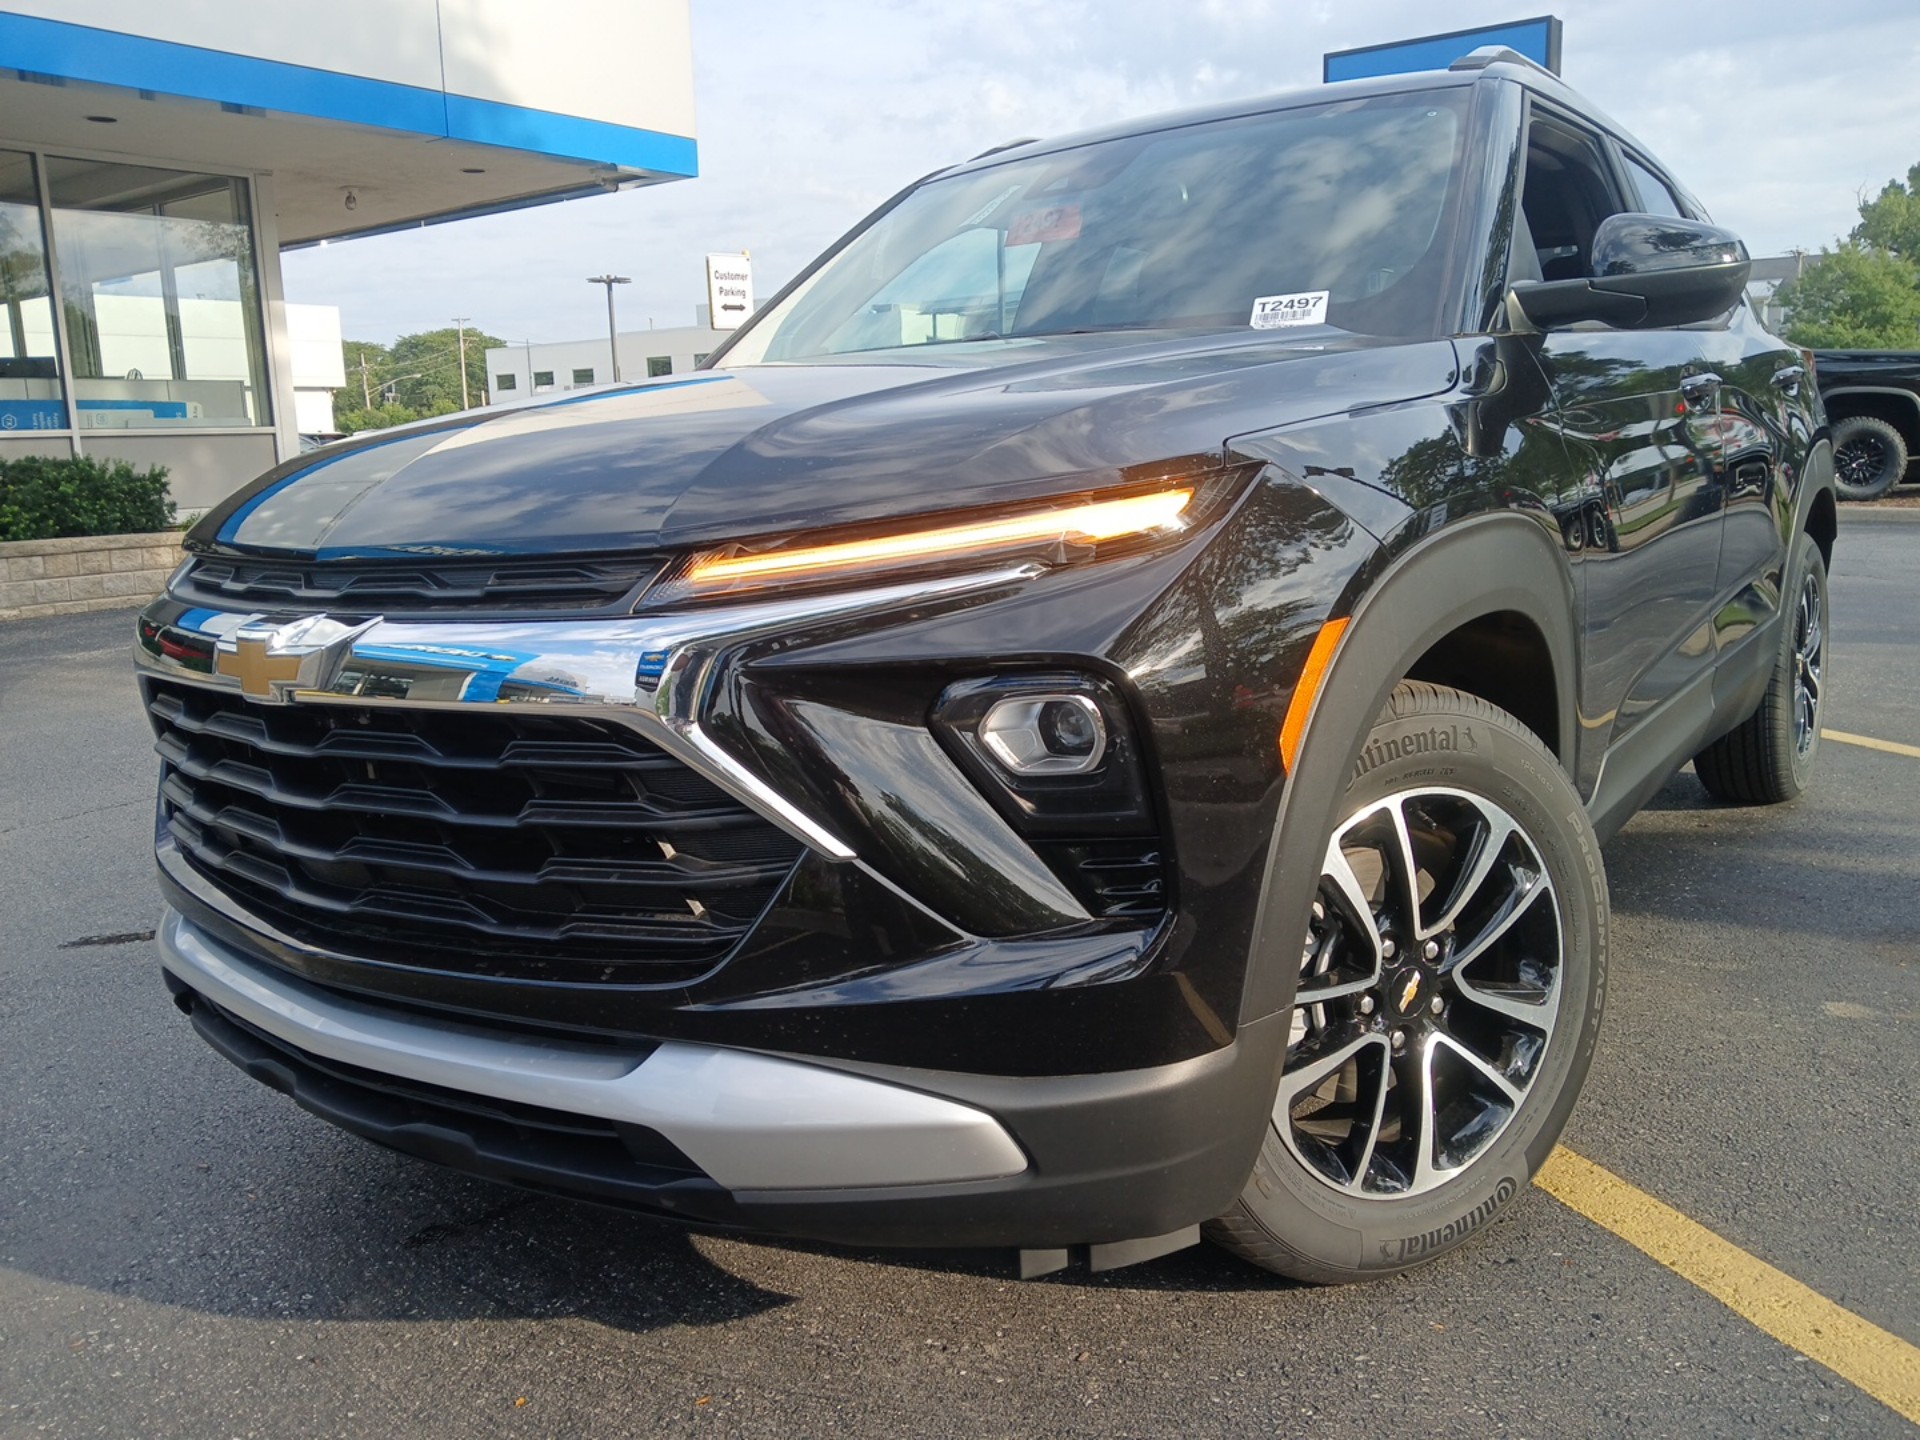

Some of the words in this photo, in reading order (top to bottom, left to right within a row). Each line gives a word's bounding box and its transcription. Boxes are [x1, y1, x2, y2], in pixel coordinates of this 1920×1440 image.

[714, 270, 748, 281] Customer
[718, 286, 746, 299] Parking
[1258, 296, 1323, 312] T2497
[1346, 725, 1458, 792] ntinental
[1399, 1176, 1517, 1260] Continental
